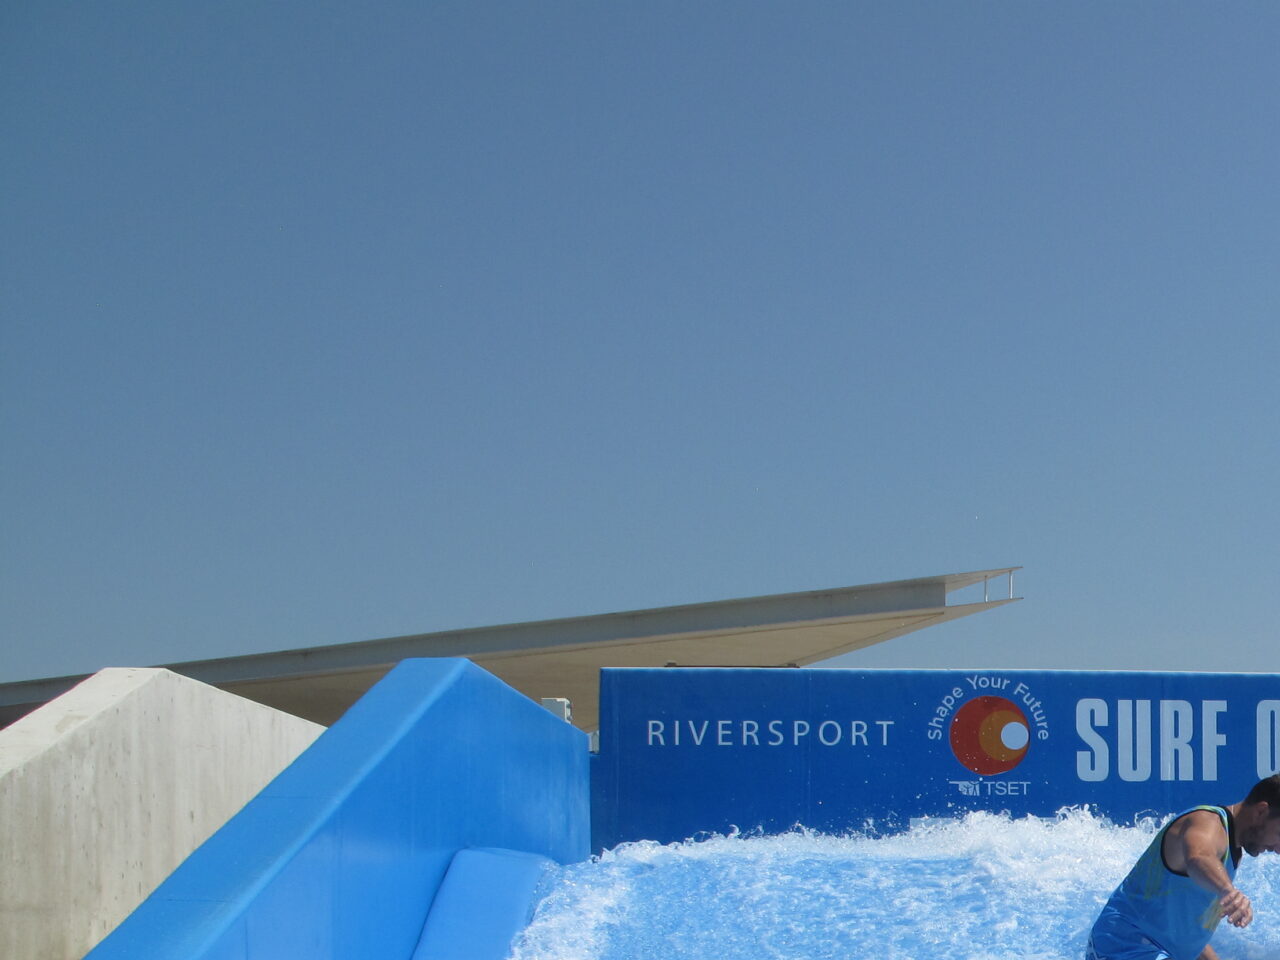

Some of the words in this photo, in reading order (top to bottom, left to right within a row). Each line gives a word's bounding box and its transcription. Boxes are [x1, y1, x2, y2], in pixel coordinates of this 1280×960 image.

[928, 687, 964, 740] Shape
[966, 675, 1011, 690] Your
[1013, 682, 1049, 740] Future
[647, 720, 894, 746] RIVERSPORT
[1075, 698, 1226, 782] SURF
[983, 781, 1031, 795] TSET
